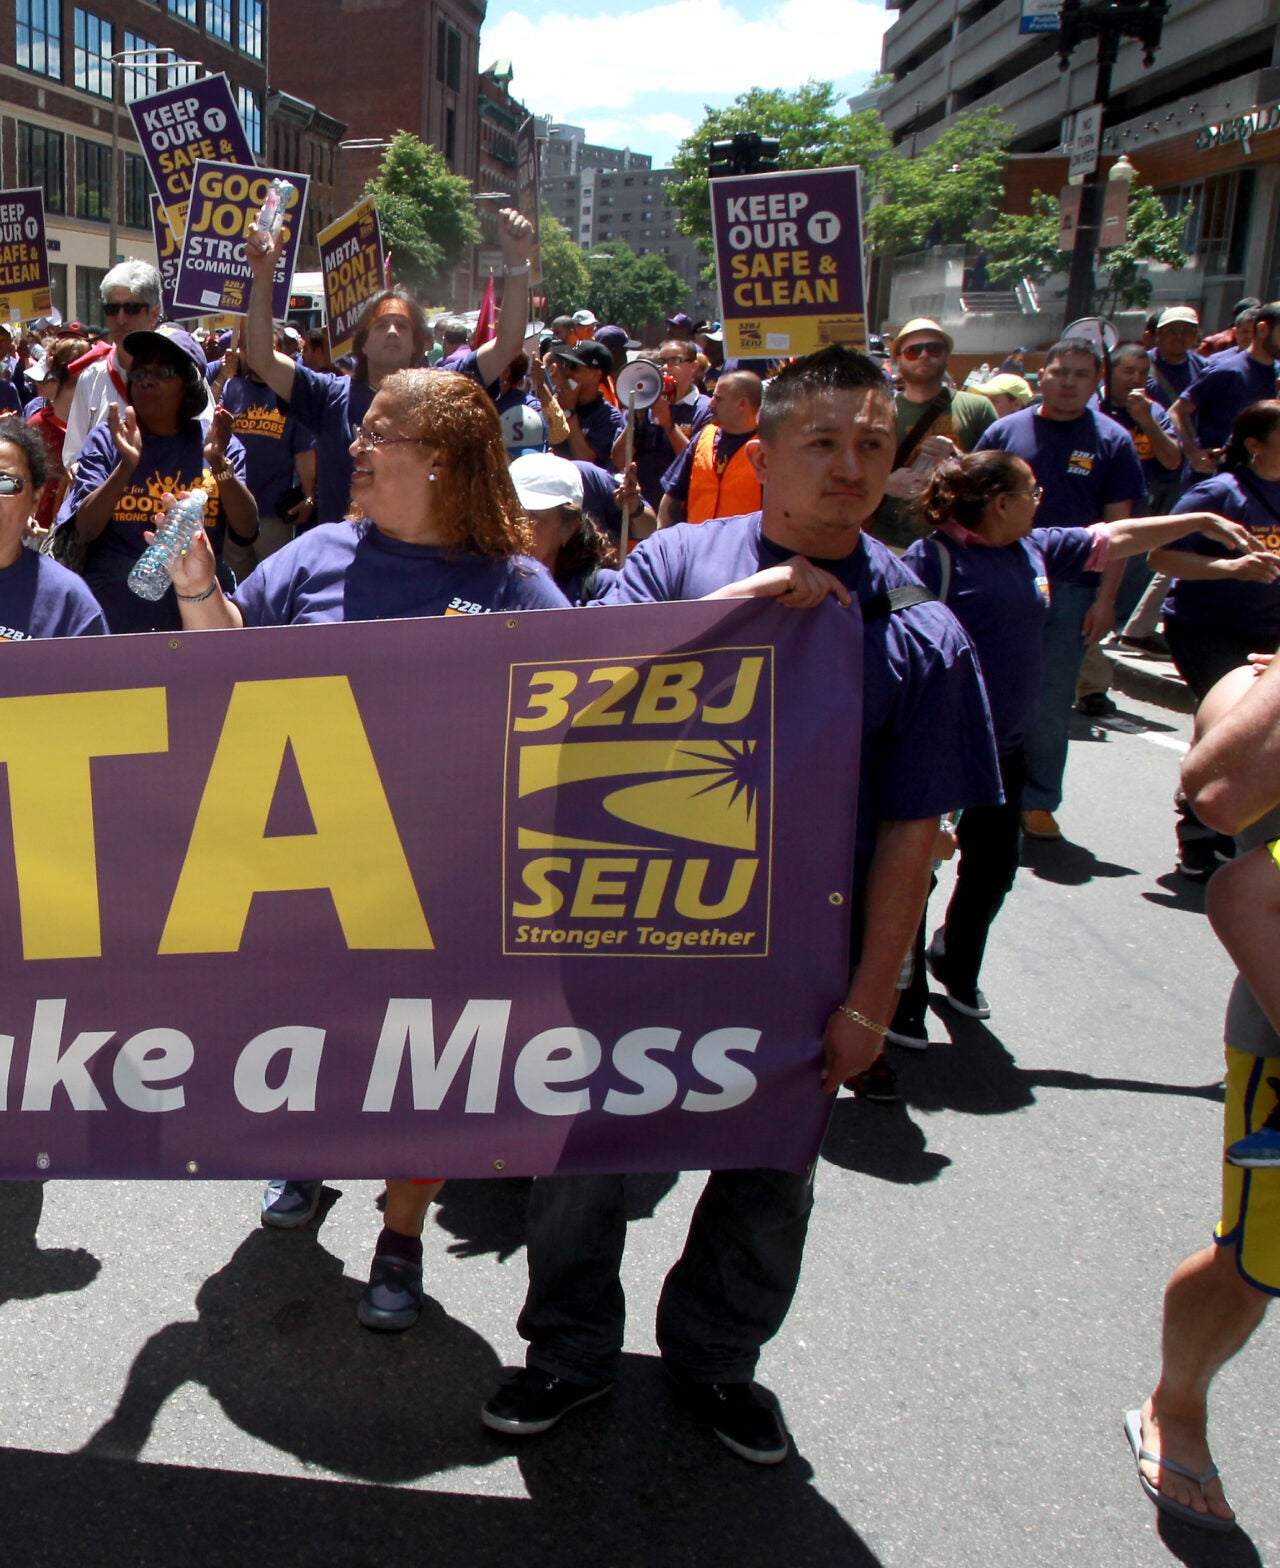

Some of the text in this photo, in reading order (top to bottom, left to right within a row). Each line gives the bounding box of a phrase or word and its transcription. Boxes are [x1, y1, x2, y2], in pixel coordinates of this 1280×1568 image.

[143, 98, 200, 132] KEEP
[151, 120, 203, 151] OUR
[158, 138, 233, 174] SAFE &
[727, 192, 808, 223] KEEP
[729, 222, 799, 250] OUR
[31, 247, 38, 260] &
[325, 236, 360, 273] MBTA
[731, 251, 838, 279] SAFE &
[327, 243, 377, 296] DON'T
[330, 269, 379, 318] MAKE
[734, 279, 839, 307] CLEAN
[336, 317, 345, 335] A
[256, 420, 284, 433] JOBS
[512, 422, 524, 441] S
[1071, 450, 1095, 461] 32BJ
[512, 656, 764, 733] 32BJ
[512, 857, 760, 920] SEIU
[515, 926, 756, 951] Stronger Together
[233, 1025, 327, 1114] a
[361, 997, 763, 1116] Mess
